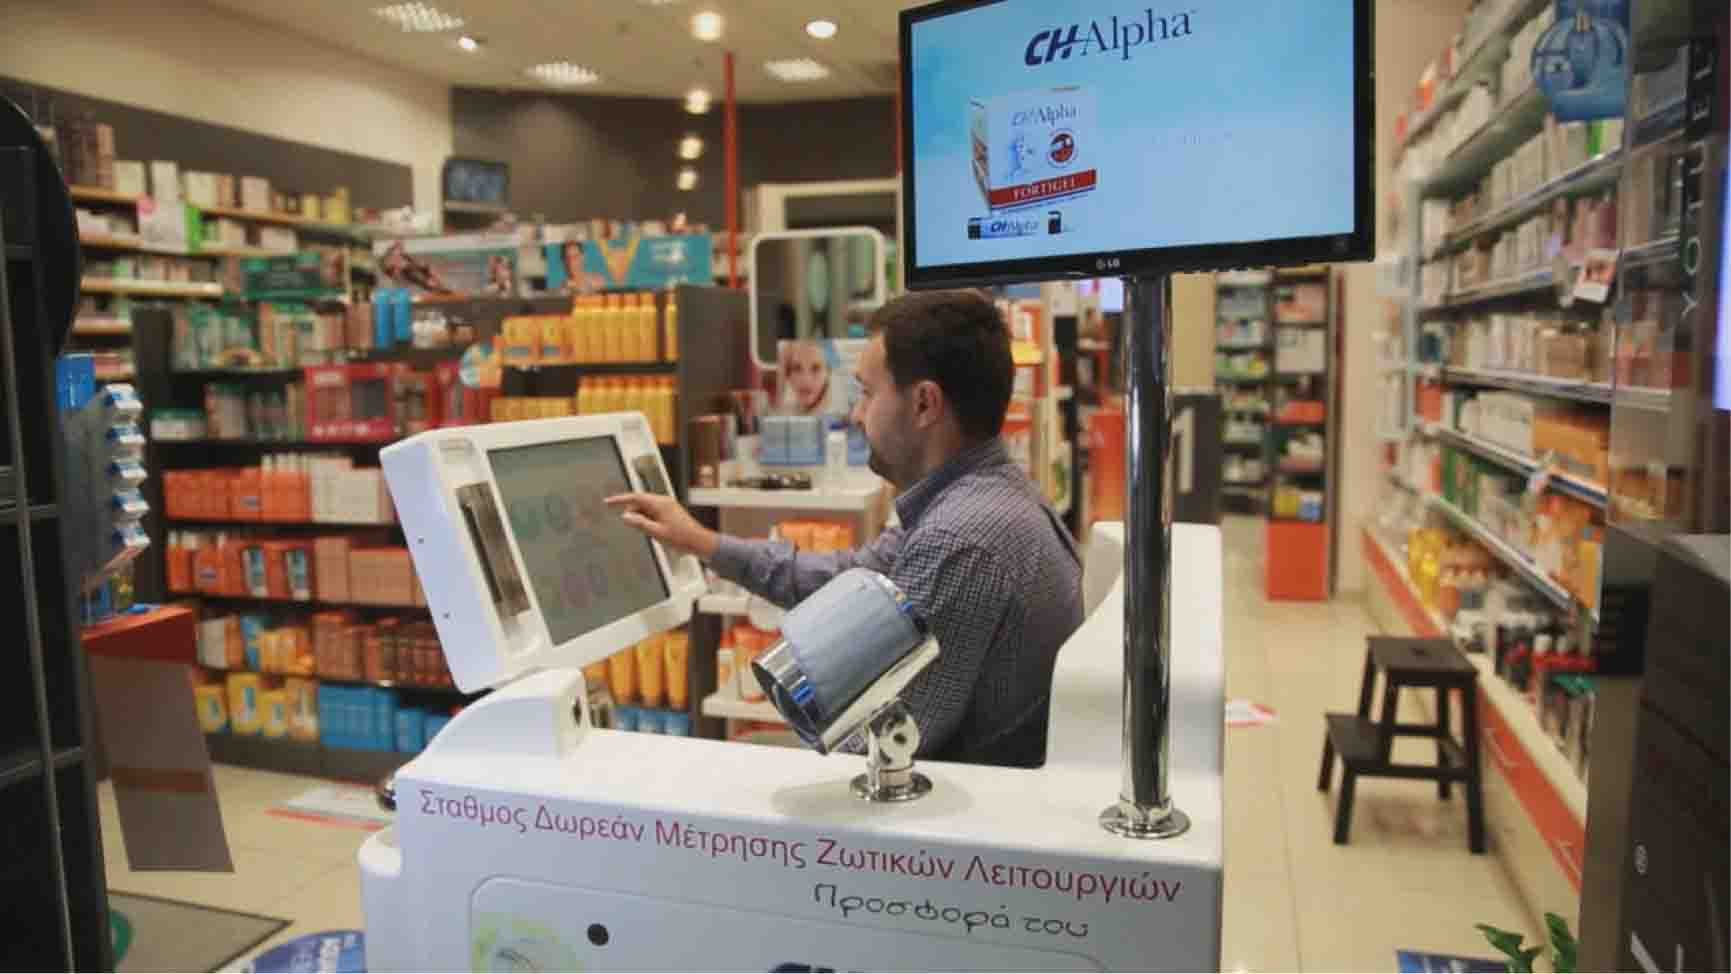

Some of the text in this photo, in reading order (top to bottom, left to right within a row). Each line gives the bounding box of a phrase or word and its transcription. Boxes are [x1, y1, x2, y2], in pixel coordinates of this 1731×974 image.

[535, 804, 645, 842] Δωρεάν
[655, 820, 807, 868] Μέτρησης
[816, 838, 955, 879] Ζωτικών
[964, 855, 1182, 903] Λειτουργιών
[814, 882, 1089, 938] Προσφορά του
